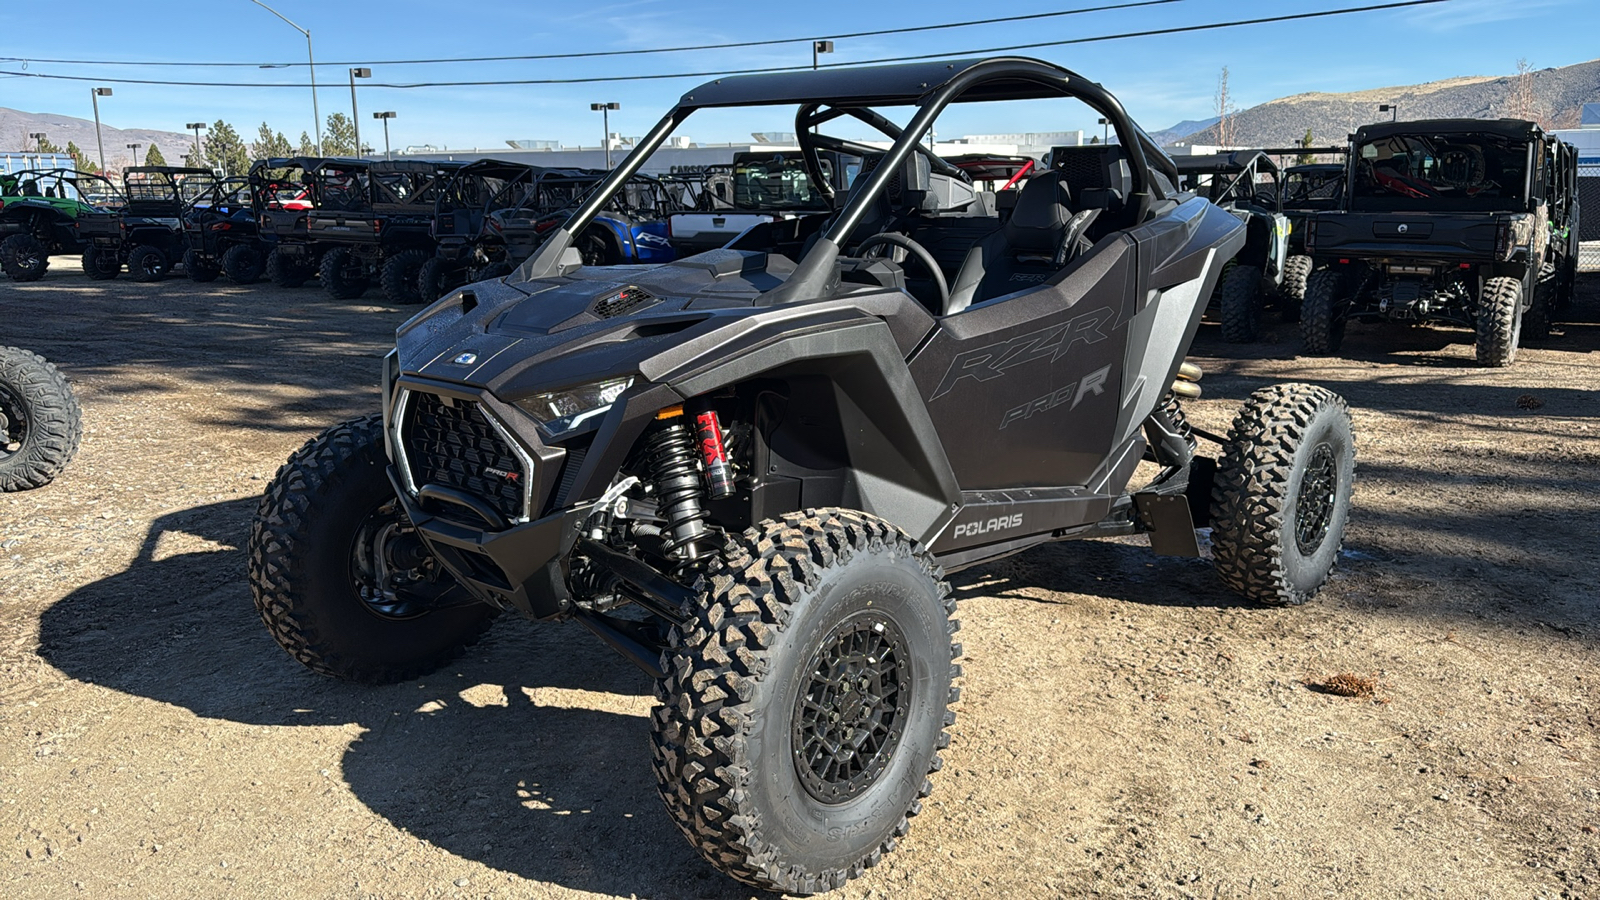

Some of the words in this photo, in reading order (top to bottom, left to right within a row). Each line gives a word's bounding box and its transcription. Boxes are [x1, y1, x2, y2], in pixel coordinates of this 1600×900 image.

[1008, 272, 1046, 283] RZR
[928, 306, 1114, 403] RZR
[999, 382, 1077, 430] PRO
[1069, 363, 1112, 412] R
[485, 467, 508, 477] PRO
[505, 472, 519, 482] R
[953, 513, 1023, 539] POLARIS
